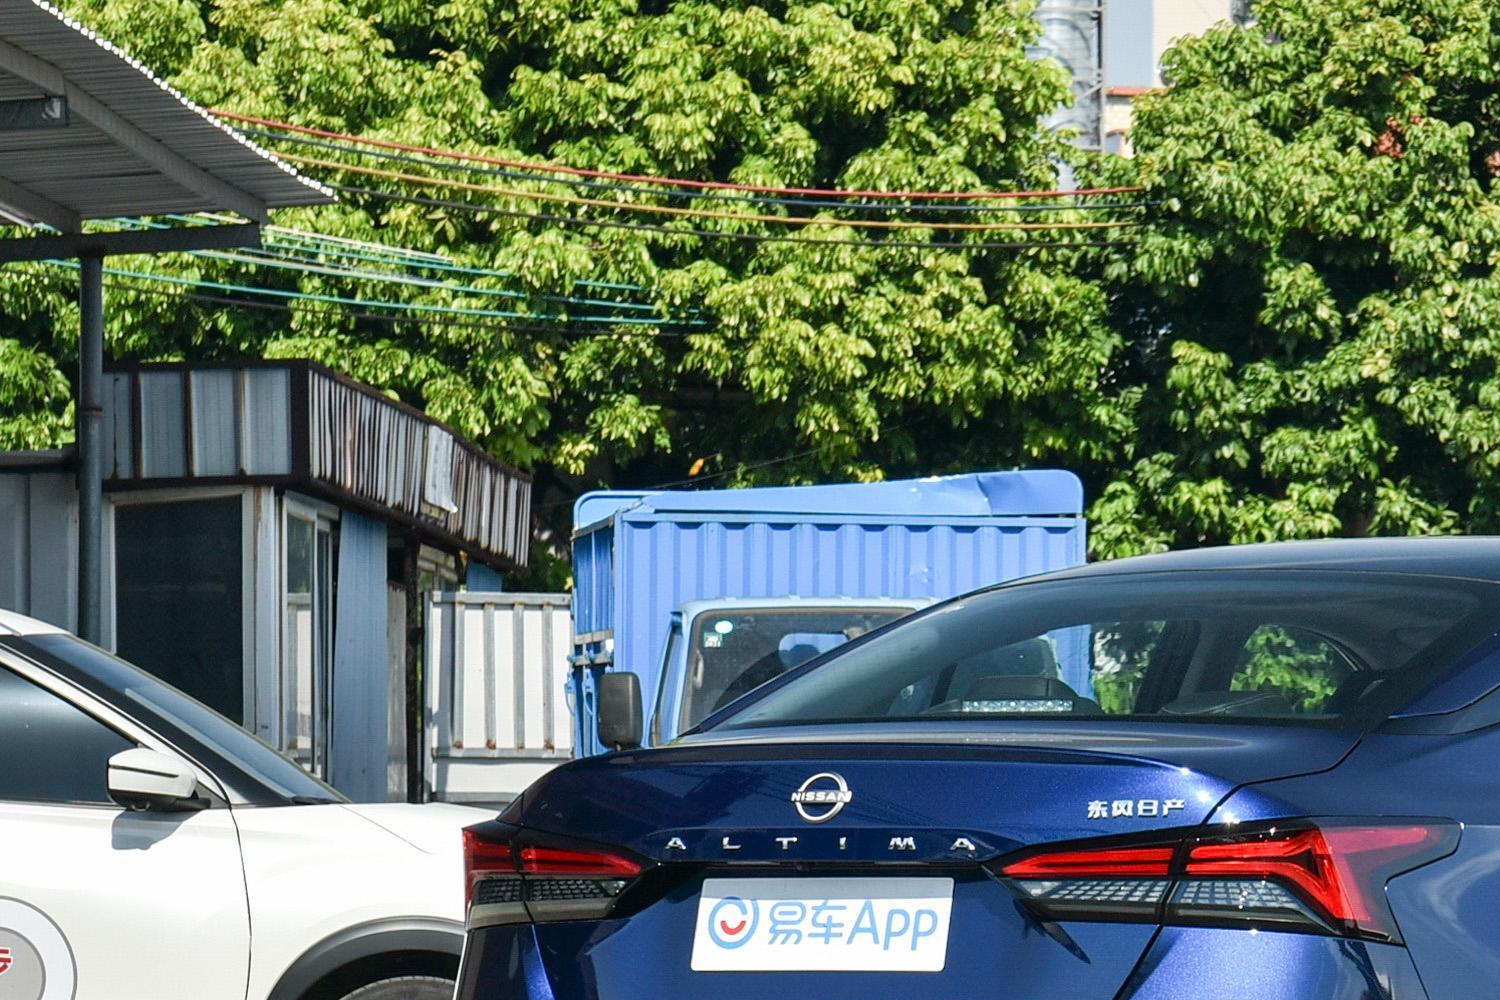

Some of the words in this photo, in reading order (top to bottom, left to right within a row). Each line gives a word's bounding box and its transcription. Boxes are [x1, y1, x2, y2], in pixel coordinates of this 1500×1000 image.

[791, 791, 852, 802] NISSAN
[1087, 799, 1185, 819] 东风日产
[665, 836, 976, 850] ALTIMA
[768, 900, 938, 951] 易车App
